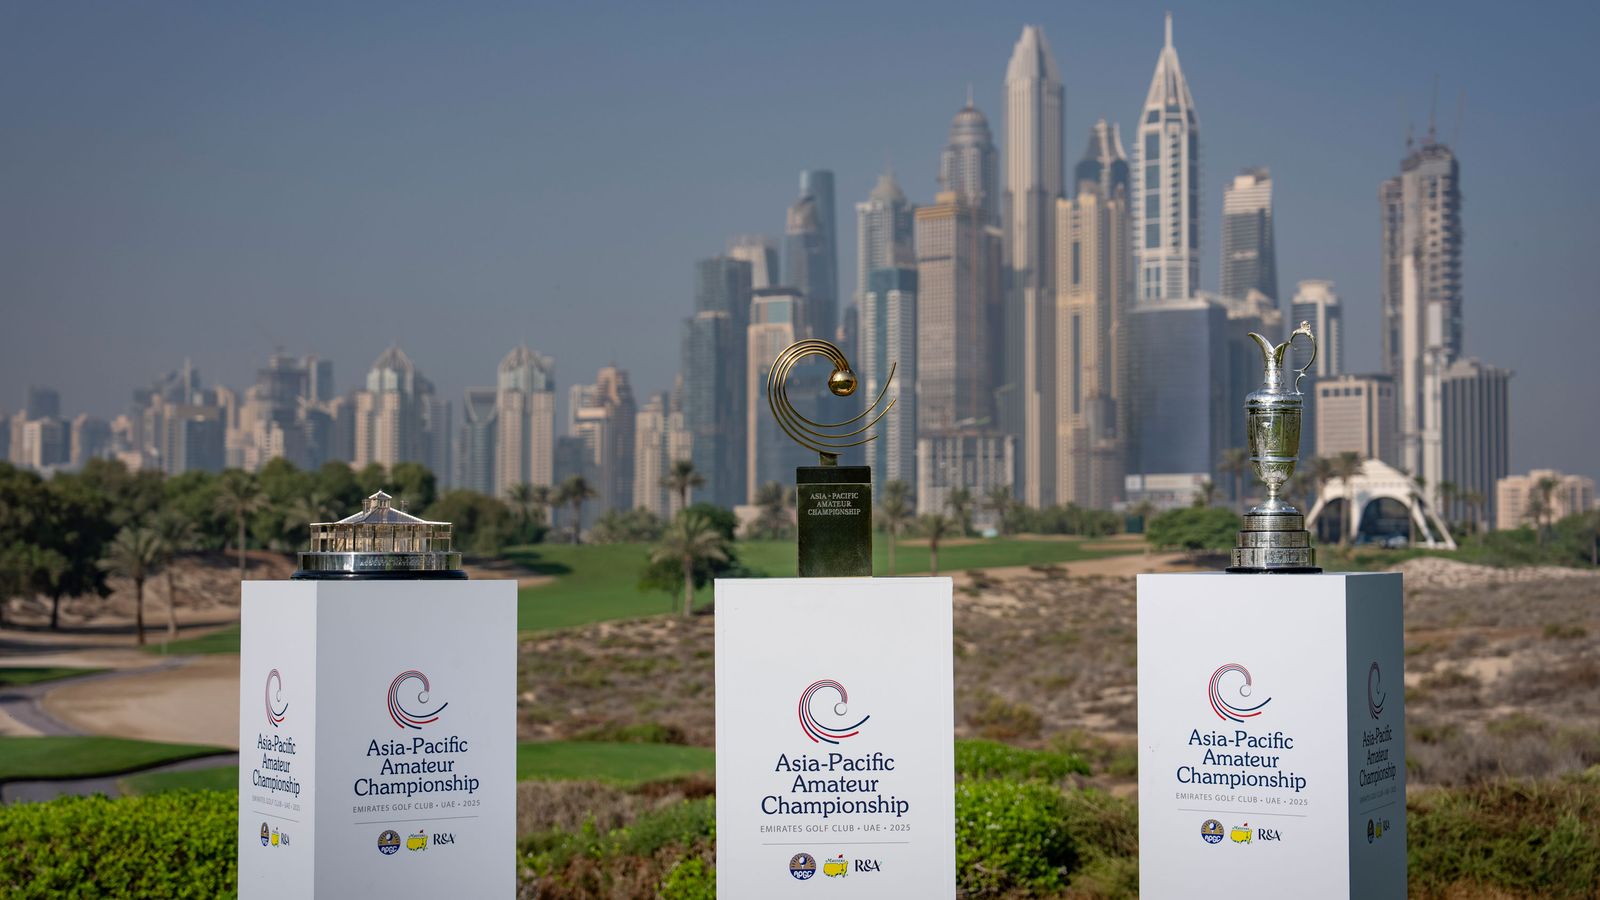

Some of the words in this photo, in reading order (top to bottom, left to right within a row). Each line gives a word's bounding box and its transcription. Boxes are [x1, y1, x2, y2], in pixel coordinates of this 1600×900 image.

[807, 508, 861, 516] CHAMPIONSHIP
[816, 500, 852, 508] AMATEUR
[257, 733, 296, 755] Asia-Pacific
[366, 735, 468, 757] Asia-Pacific
[1188, 728, 1294, 750] Asia-Pacific
[1363, 724, 1392, 748] Asia-Pacific
[262, 753, 290, 773] Amateur
[380, 758, 455, 775] Amateur
[775, 752, 895, 772] Asia-Pacific
[1202, 748, 1280, 768] Amateur
[1367, 748, 1388, 766] Amateur
[253, 769, 300, 798] Championship
[791, 774, 879, 793] Amateur
[1176, 766, 1307, 793] Championship
[1360, 761, 1396, 787] Championship
[354, 774, 479, 797] Championship
[352, 804, 390, 813] EMIRATES
[392, 803, 412, 811] GOLF
[414, 802, 434, 810] CLUB
[440, 800, 456, 808] UAE
[463, 799, 480, 807] 2025
[761, 794, 909, 818] Championship
[1175, 792, 1213, 801] EMIRATES
[1214, 794, 1236, 802] GOLF
[1237, 795, 1258, 803] CLUB
[1265, 797, 1281, 805] UAE
[1289, 798, 1308, 806] 2025
[760, 825, 803, 833] EMIRATES
[805, 824, 829, 832] GOLF
[831, 824, 855, 832] CLUB
[863, 824, 881, 832] UAE
[889, 823, 911, 832] 2025
[1258, 828, 1281, 841] R&A
[433, 832, 455, 845] R&A
[855, 859, 880, 872] R&A
